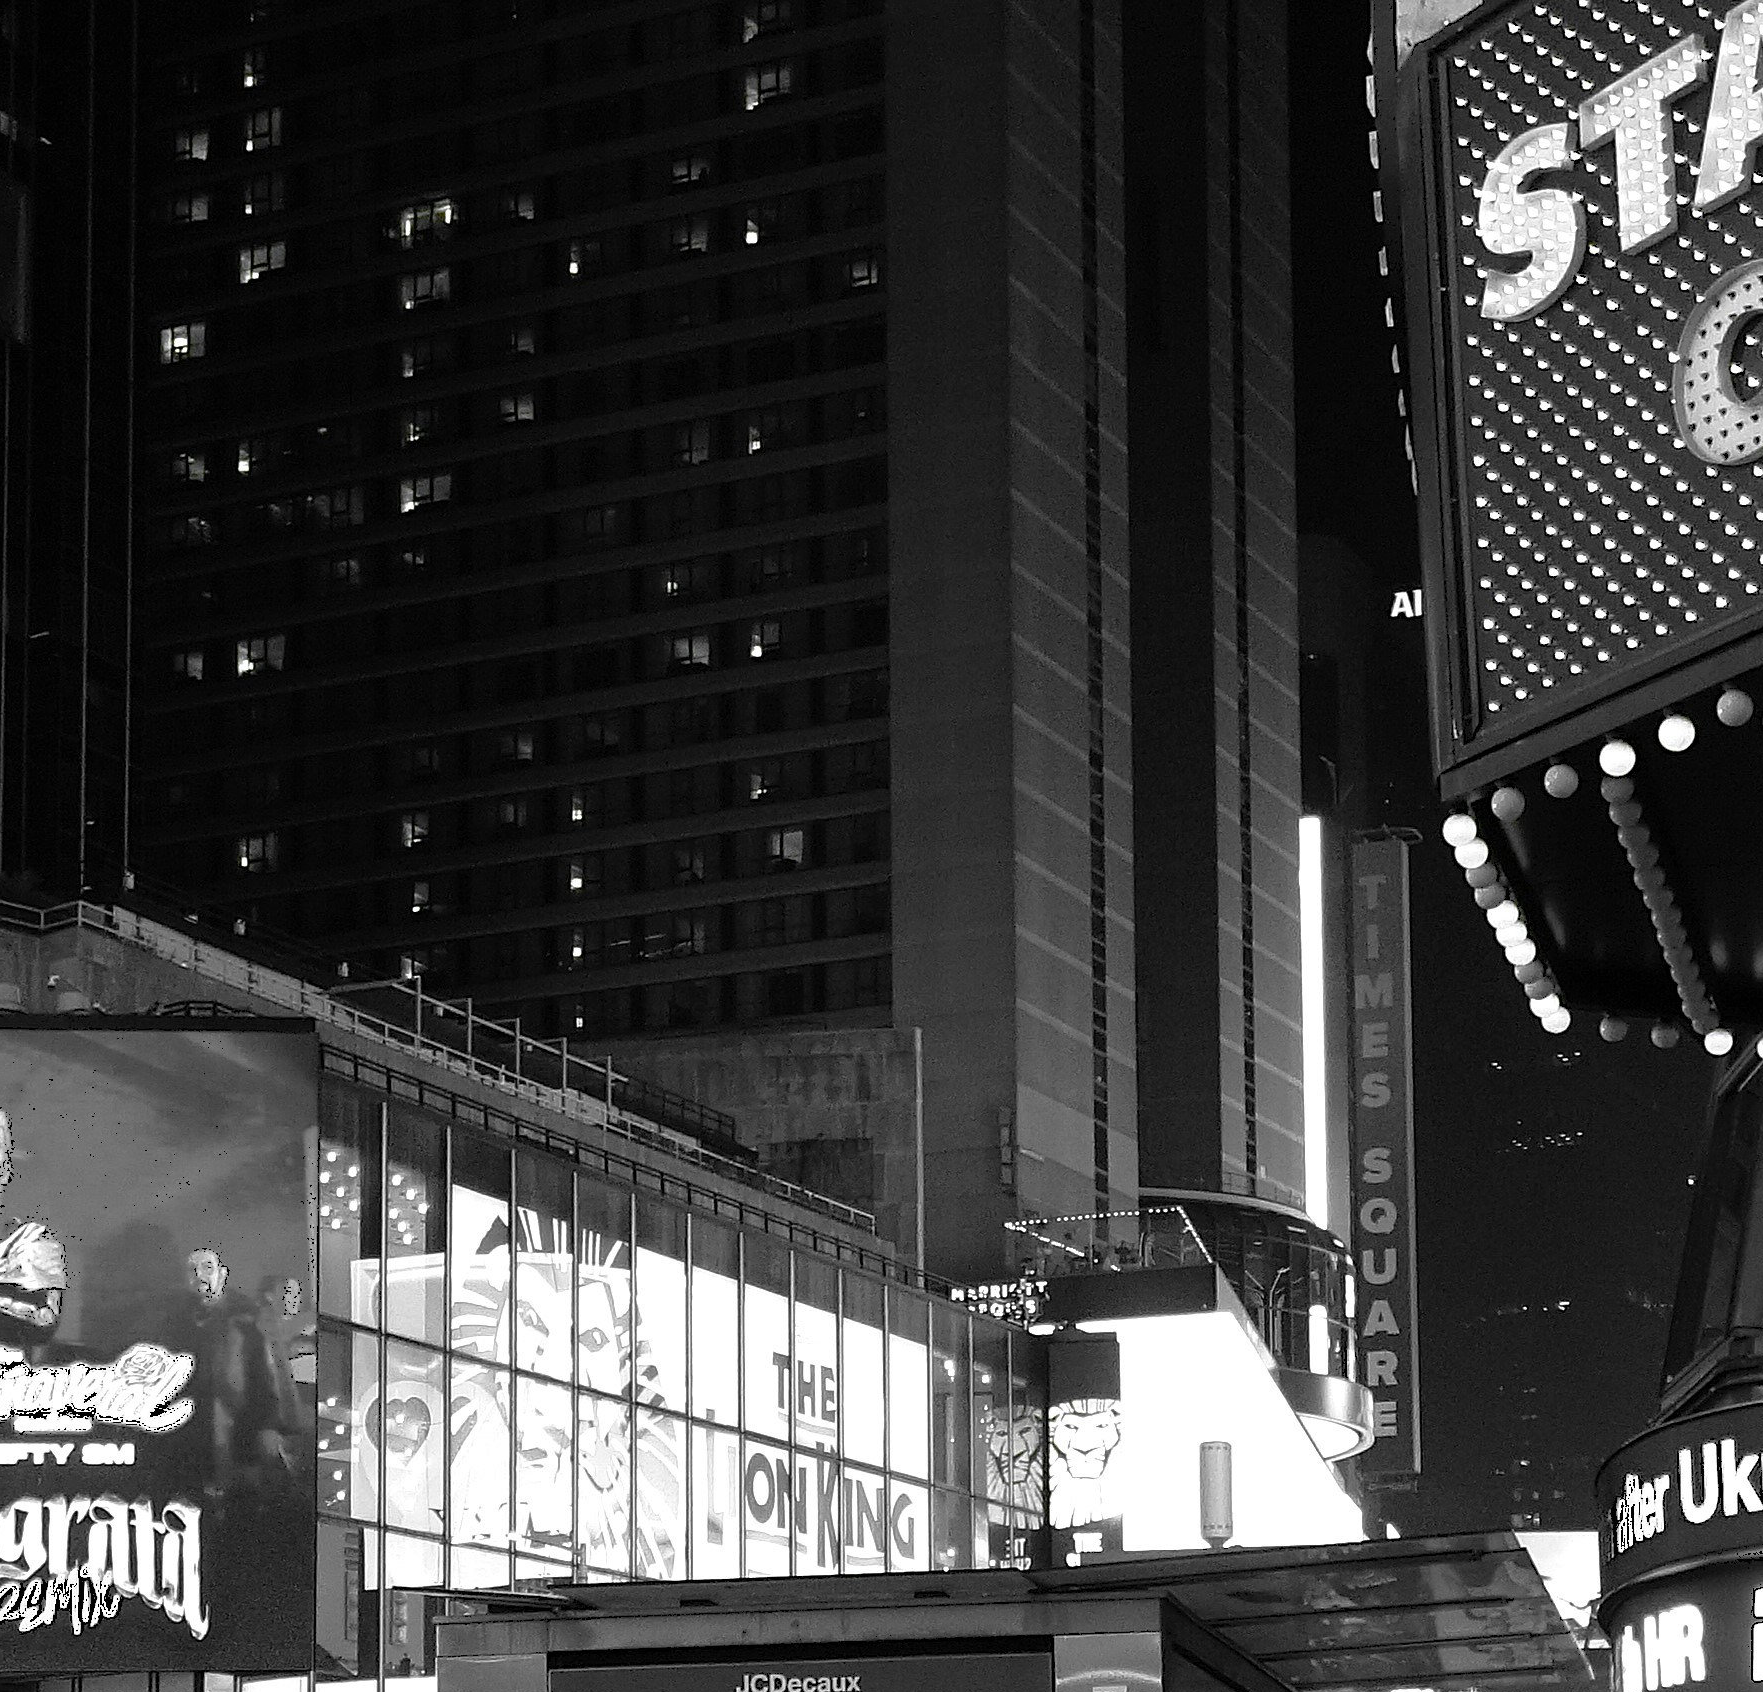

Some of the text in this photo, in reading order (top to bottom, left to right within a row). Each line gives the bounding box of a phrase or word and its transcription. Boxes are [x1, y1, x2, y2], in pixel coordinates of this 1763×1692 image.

[1354, 875, 1394, 1108] TIMES
[1358, 1146, 1399, 1440] SQUARE
[772, 1351, 836, 1423] THE
[816, 1441, 915, 1569] KING
[1643, 1604, 1706, 1692] HR
